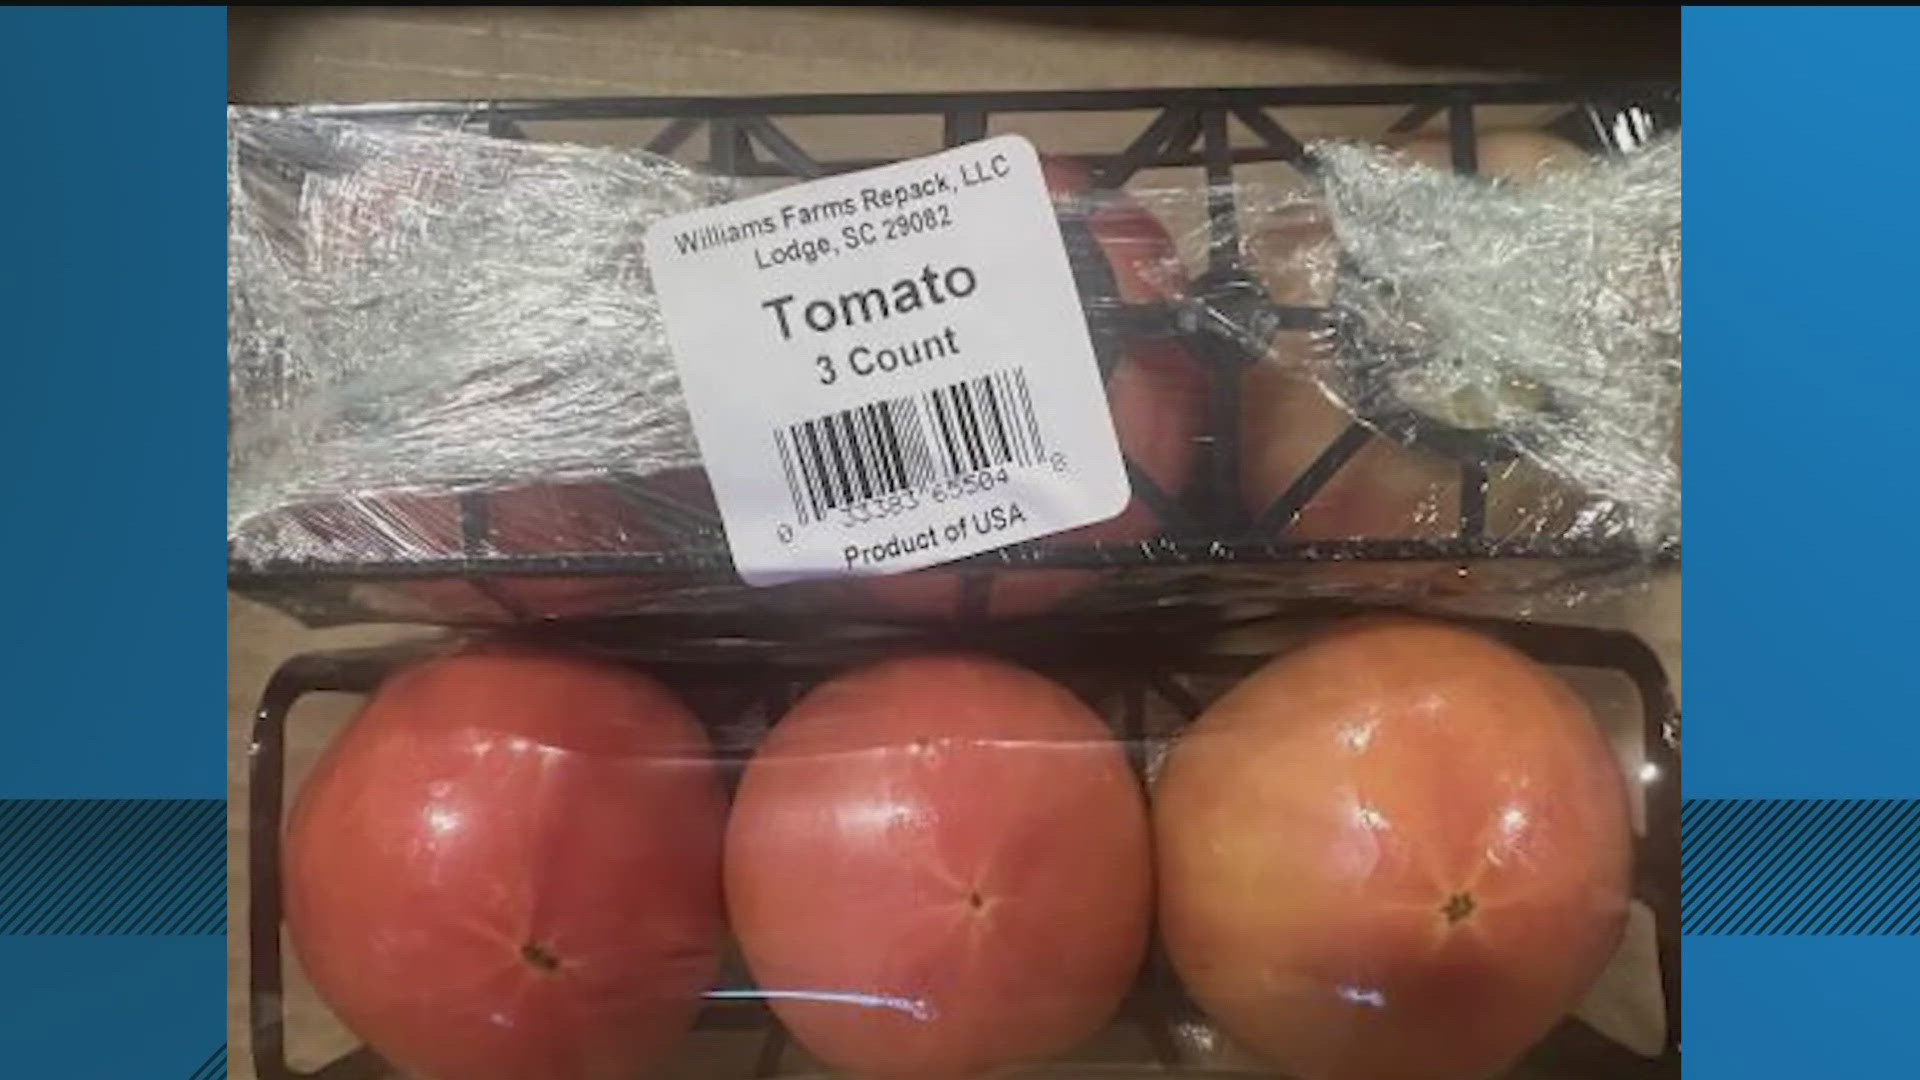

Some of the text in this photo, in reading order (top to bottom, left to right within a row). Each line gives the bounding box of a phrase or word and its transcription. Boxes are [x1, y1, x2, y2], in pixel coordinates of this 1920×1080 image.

[674, 154, 1011, 256] Williams Farms Repack, LLC
[754, 204, 953, 270] Lodge, SC 29082
[762, 263, 978, 341] Tomato
[816, 327, 960, 385] 3 Count
[844, 503, 1028, 570] Product of USA
